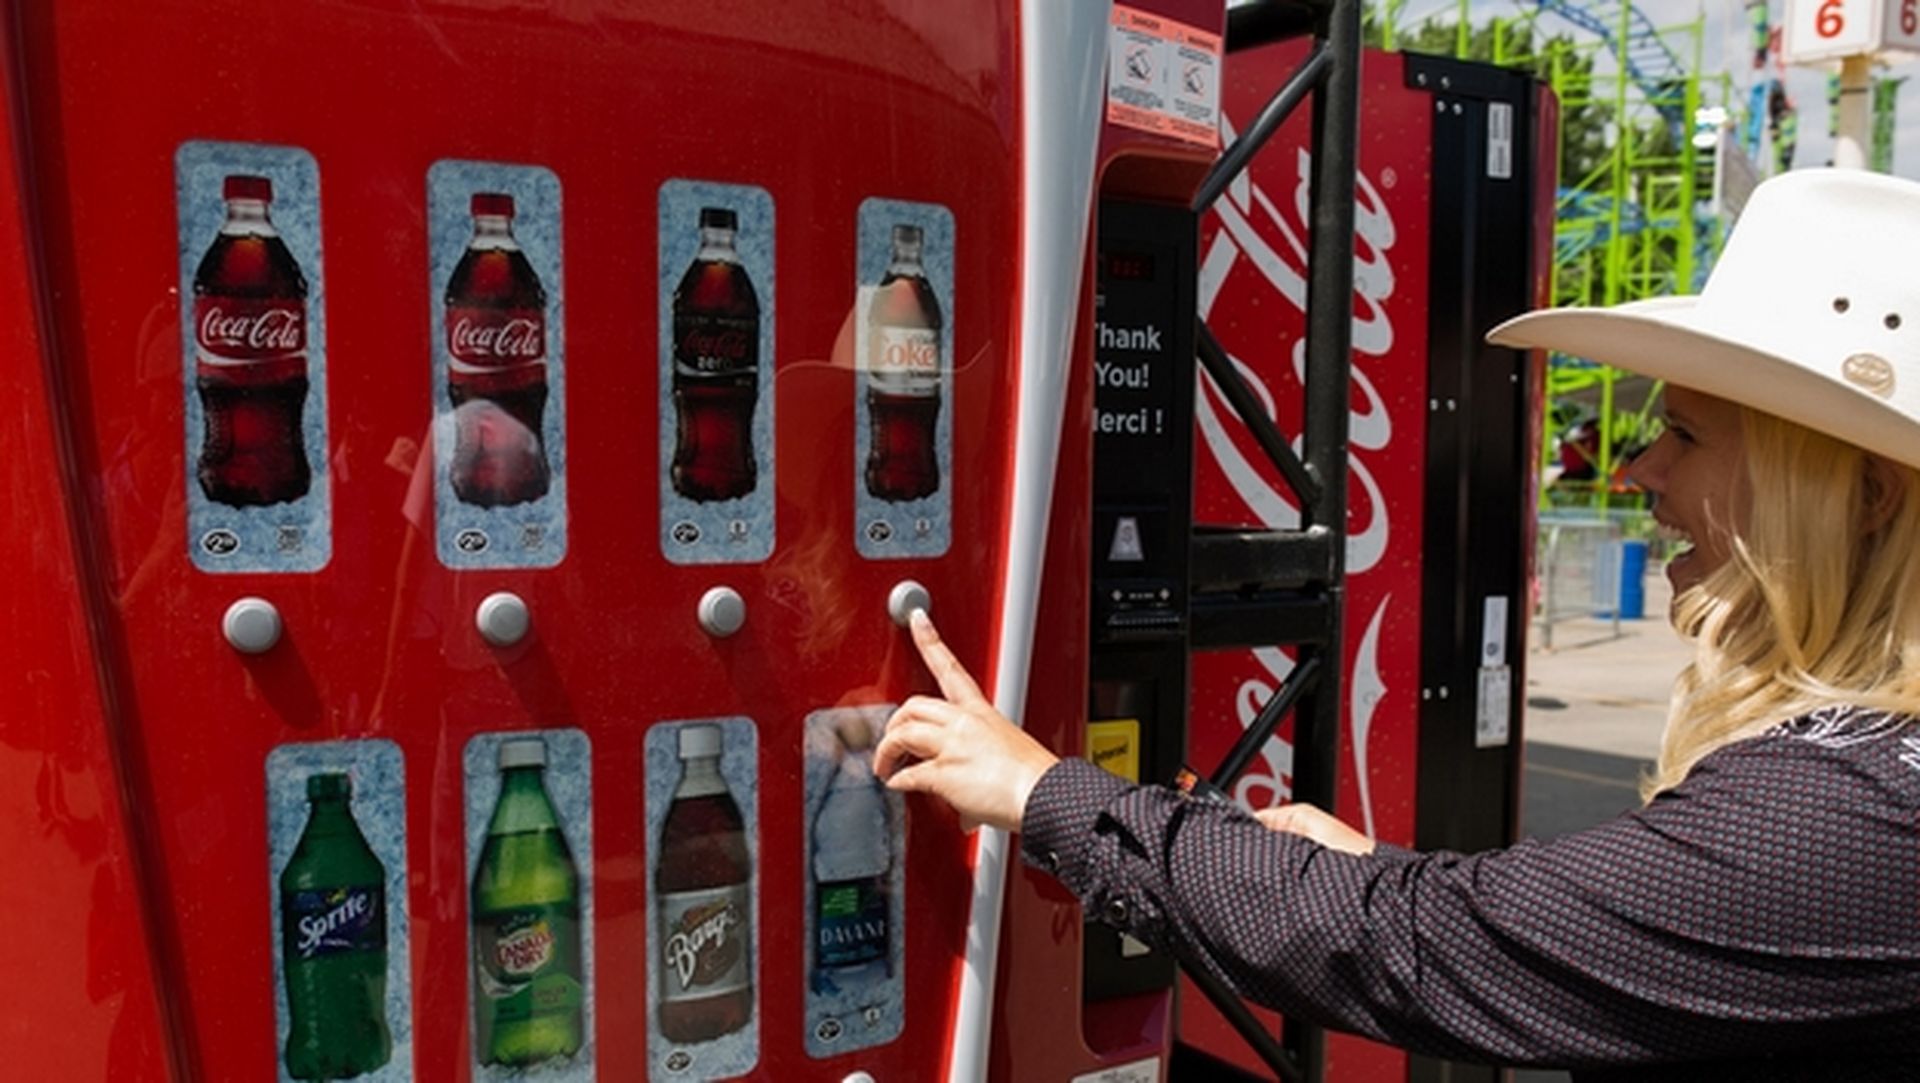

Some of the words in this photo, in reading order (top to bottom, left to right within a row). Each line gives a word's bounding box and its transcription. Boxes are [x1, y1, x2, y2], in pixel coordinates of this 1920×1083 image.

[1816, 0, 1843, 38] 6
[202, 307, 299, 348] Coca-Cola
[453, 318, 539, 356] Coca-Cola
[1095, 322, 1161, 351] hank
[1095, 362, 1149, 388] You!
[1093, 408, 1147, 433] erci
[298, 893, 367, 958] Sprite
